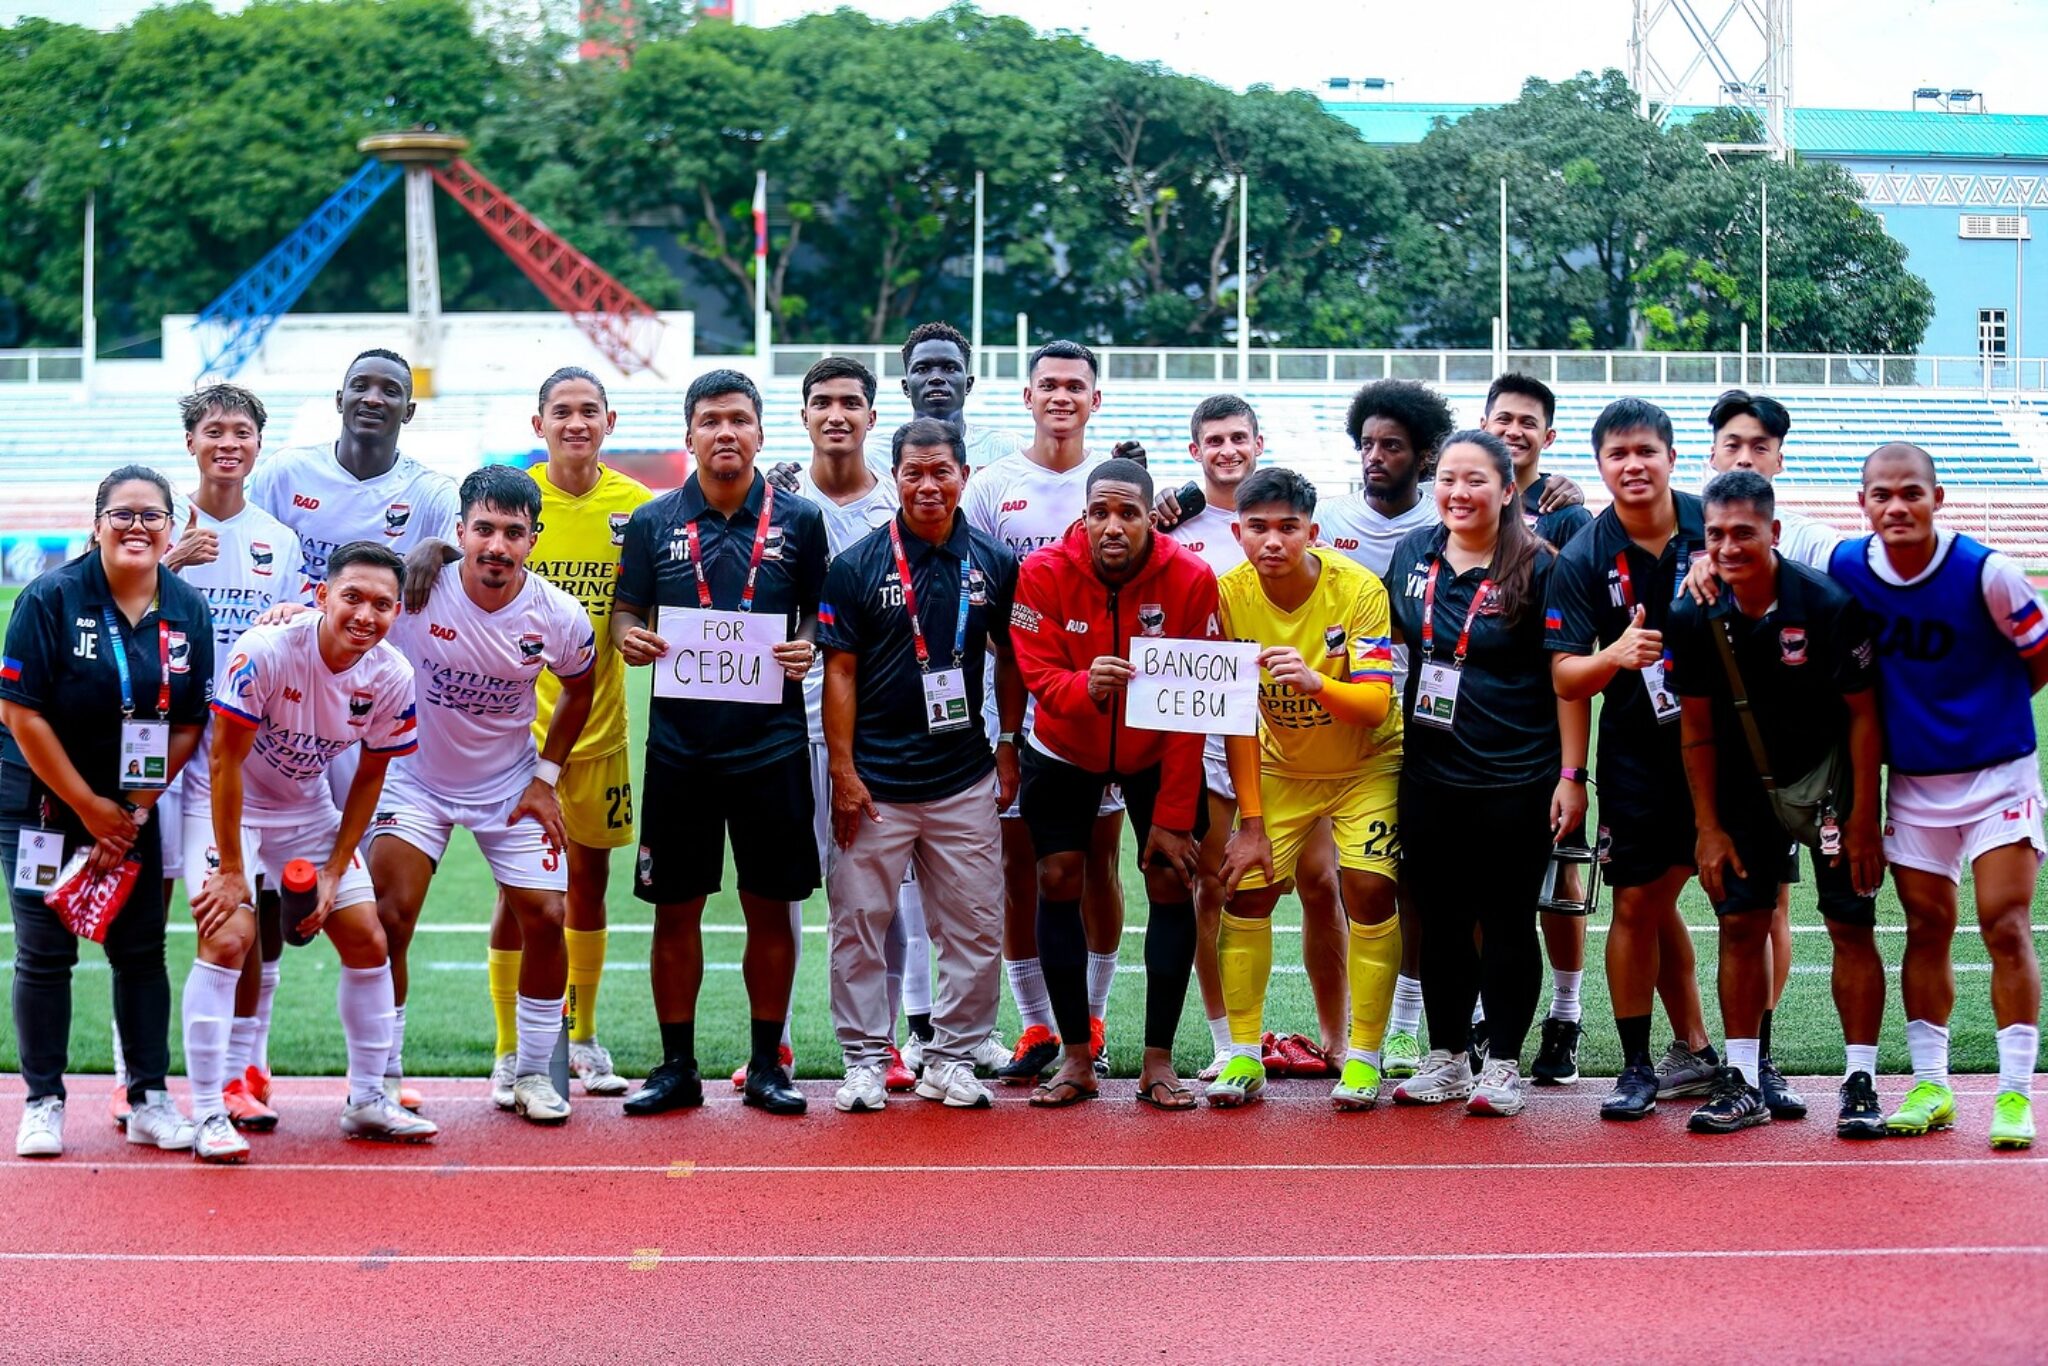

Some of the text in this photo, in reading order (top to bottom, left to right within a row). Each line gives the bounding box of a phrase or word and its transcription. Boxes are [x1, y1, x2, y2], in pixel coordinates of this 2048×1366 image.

[293, 494, 320, 510] RAD
[1001, 500, 1028, 513] RAD
[673, 528, 688, 536] RA
[1334, 538, 1359, 550] RAD
[879, 584, 907, 609] TG
[76, 617, 96, 628] RAD
[429, 624, 457, 641] RAD
[703, 620, 745, 642] FOR
[1065, 619, 1089, 634] RAD
[73, 632, 98, 659] JE
[674, 649, 761, 686] CEBU
[1144, 647, 1238, 682] BANGON
[432, 675, 522, 704] SPRING
[1157, 688, 1226, 718] CEBU
[606, 783, 634, 830] 23
[541, 832, 559, 872] 3
